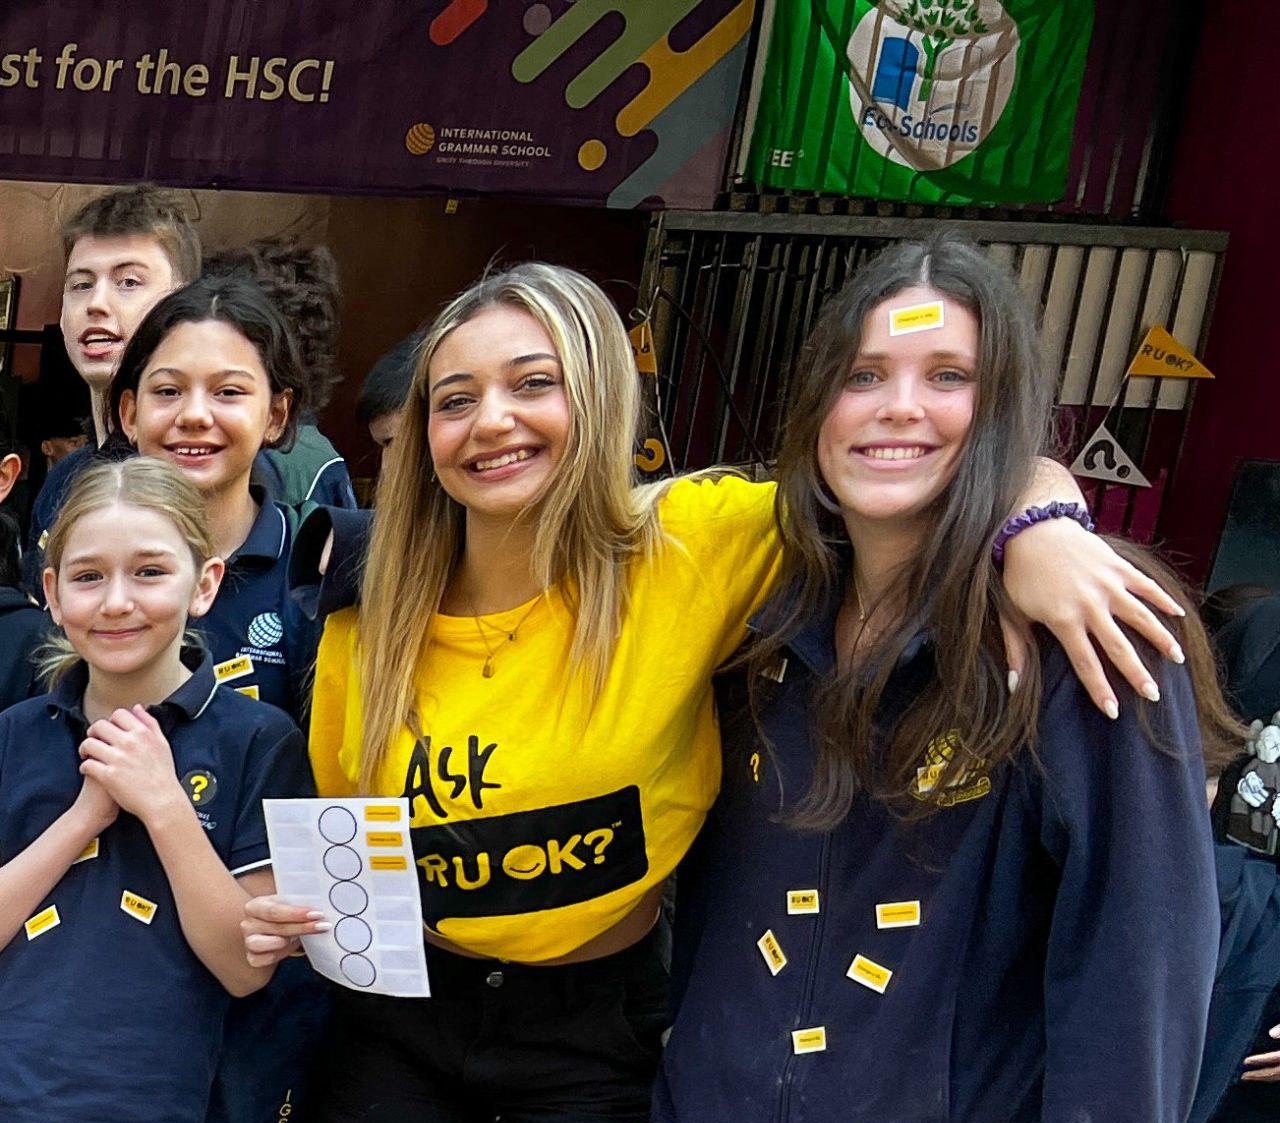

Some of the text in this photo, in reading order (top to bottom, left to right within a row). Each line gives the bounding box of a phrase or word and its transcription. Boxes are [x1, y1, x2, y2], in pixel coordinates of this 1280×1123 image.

[55, 44, 123, 91] for
[136, 49, 210, 96] the
[224, 55, 336, 102] HSC!
[440, 128, 534, 142] INTERNATIONAL
[862, 106, 978, 143] Eco-Schools
[438, 142, 552, 157] GRAMMAR SCHOOL
